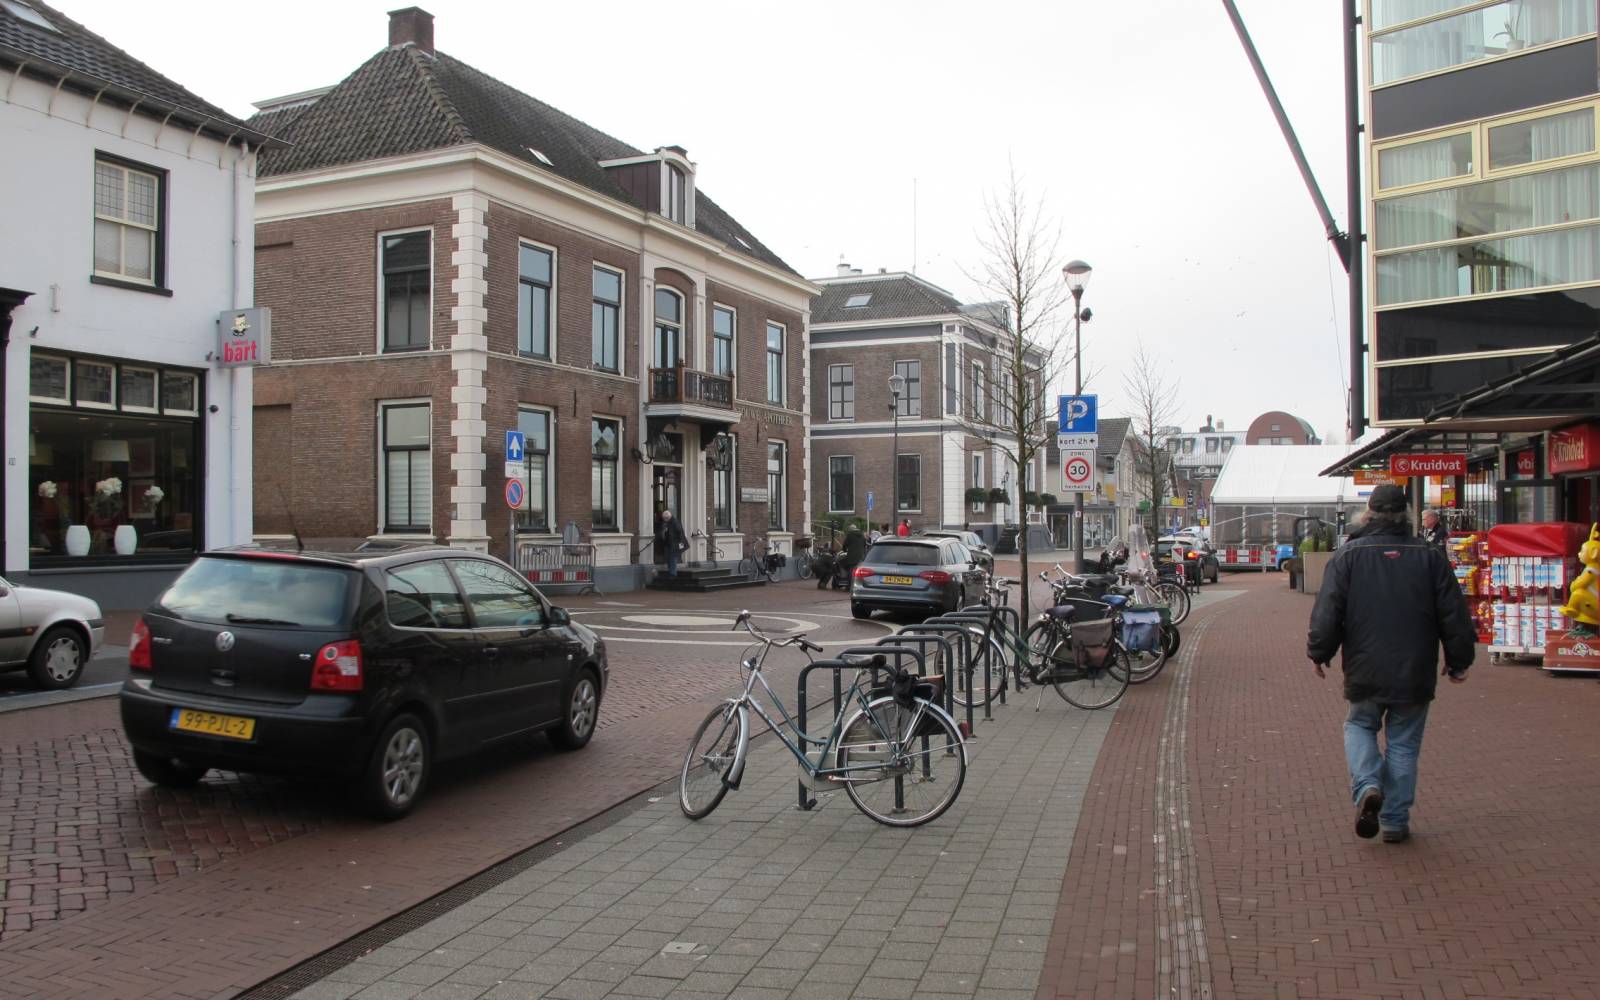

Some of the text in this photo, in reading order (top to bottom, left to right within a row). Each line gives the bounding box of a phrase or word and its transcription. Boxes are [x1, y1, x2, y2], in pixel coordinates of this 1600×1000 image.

[223, 341, 257, 363] bart
[1067, 400, 1088, 430] P
[1060, 437, 1075, 445] kort
[1558, 436, 1585, 463] Kruidvat
[1070, 465, 1086, 476] 30
[1411, 458, 1462, 471] Kruidvat
[184, 712, 248, 736] 99-PJL-2
